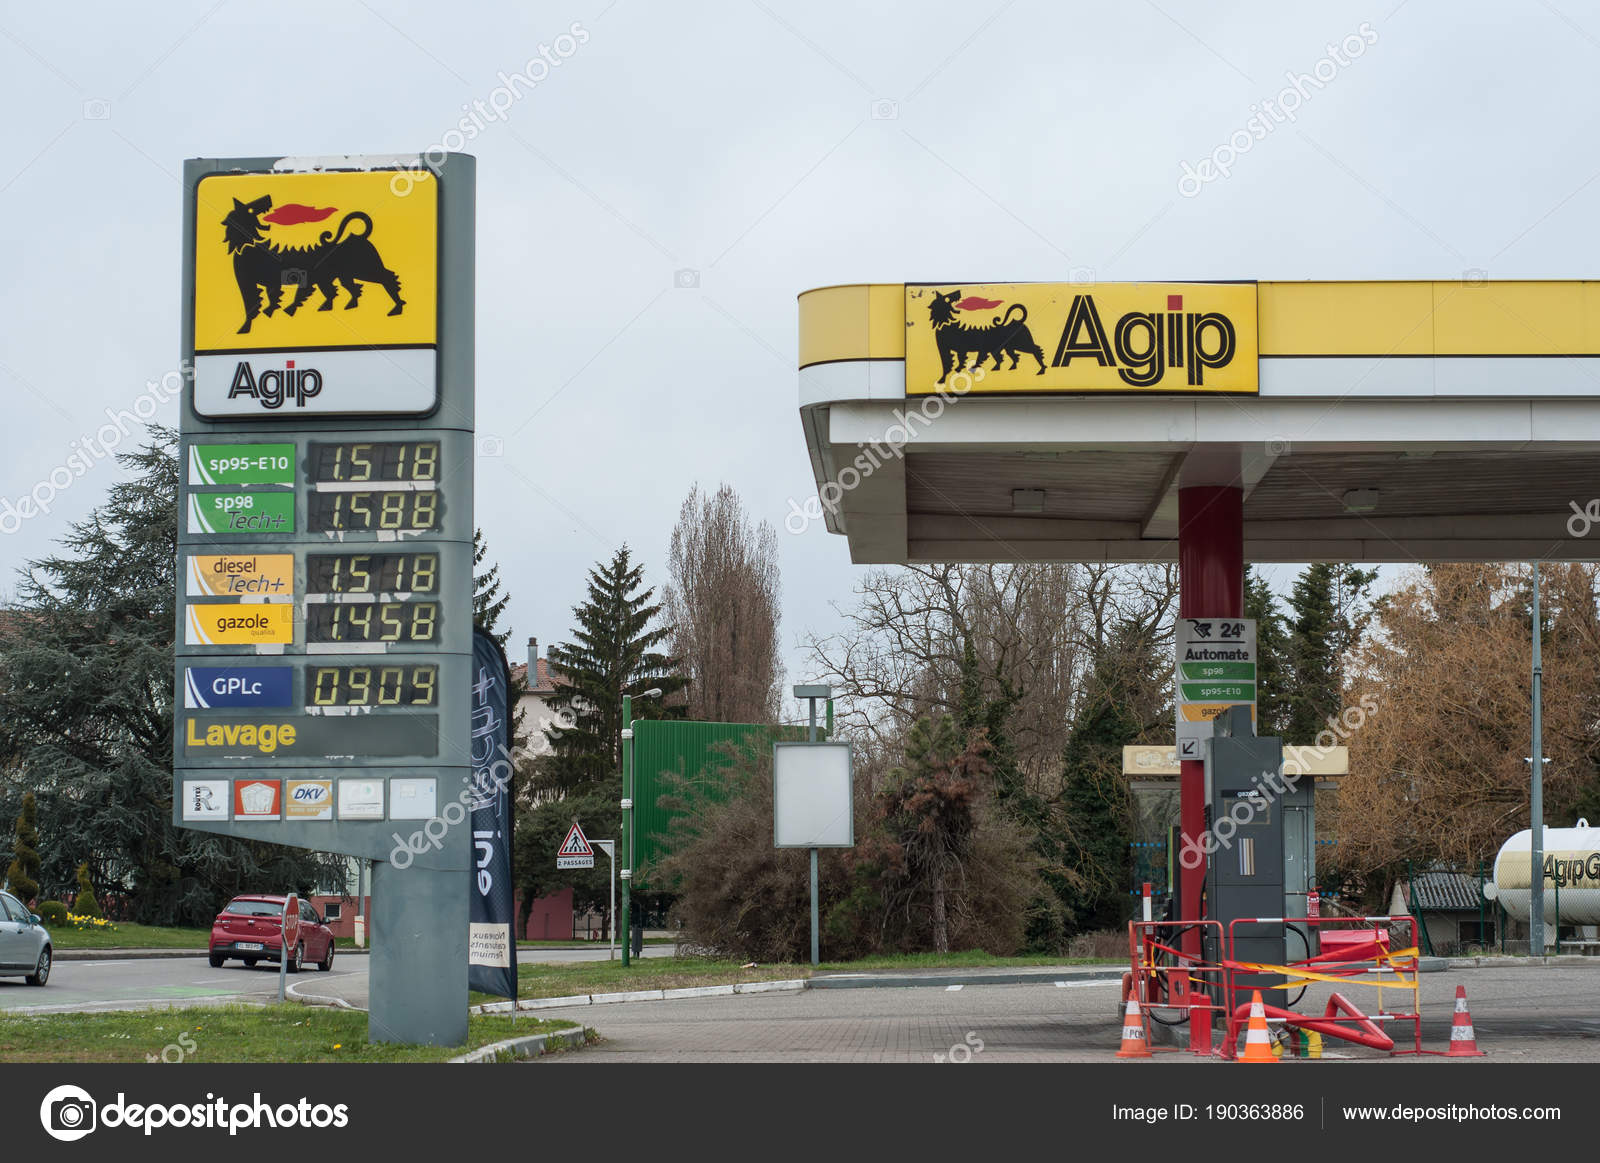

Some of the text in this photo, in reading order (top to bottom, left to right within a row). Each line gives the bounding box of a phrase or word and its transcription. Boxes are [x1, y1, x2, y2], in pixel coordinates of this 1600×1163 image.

[1051, 294, 1237, 388] Agip
[228, 360, 323, 410] Agip
[210, 456, 289, 475] sp95-E10
[332, 444, 438, 482] 1.518
[215, 495, 254, 511] sp98
[332, 491, 438, 530] 1.588
[227, 510, 286, 530] Tech+
[213, 557, 256, 574] diesel
[332, 555, 437, 593] 1.518
[226, 574, 285, 593] Tech+
[217, 613, 269, 633] gazole
[332, 603, 436, 641] 1.458
[1185, 648, 1249, 661] Automate
[1202, 667, 1224, 676] sp98
[212, 677, 263, 696] GPLc
[1201, 687, 1242, 696] sp95-E10
[187, 718, 297, 753] Lavage
[294, 787, 325, 800] DKV
